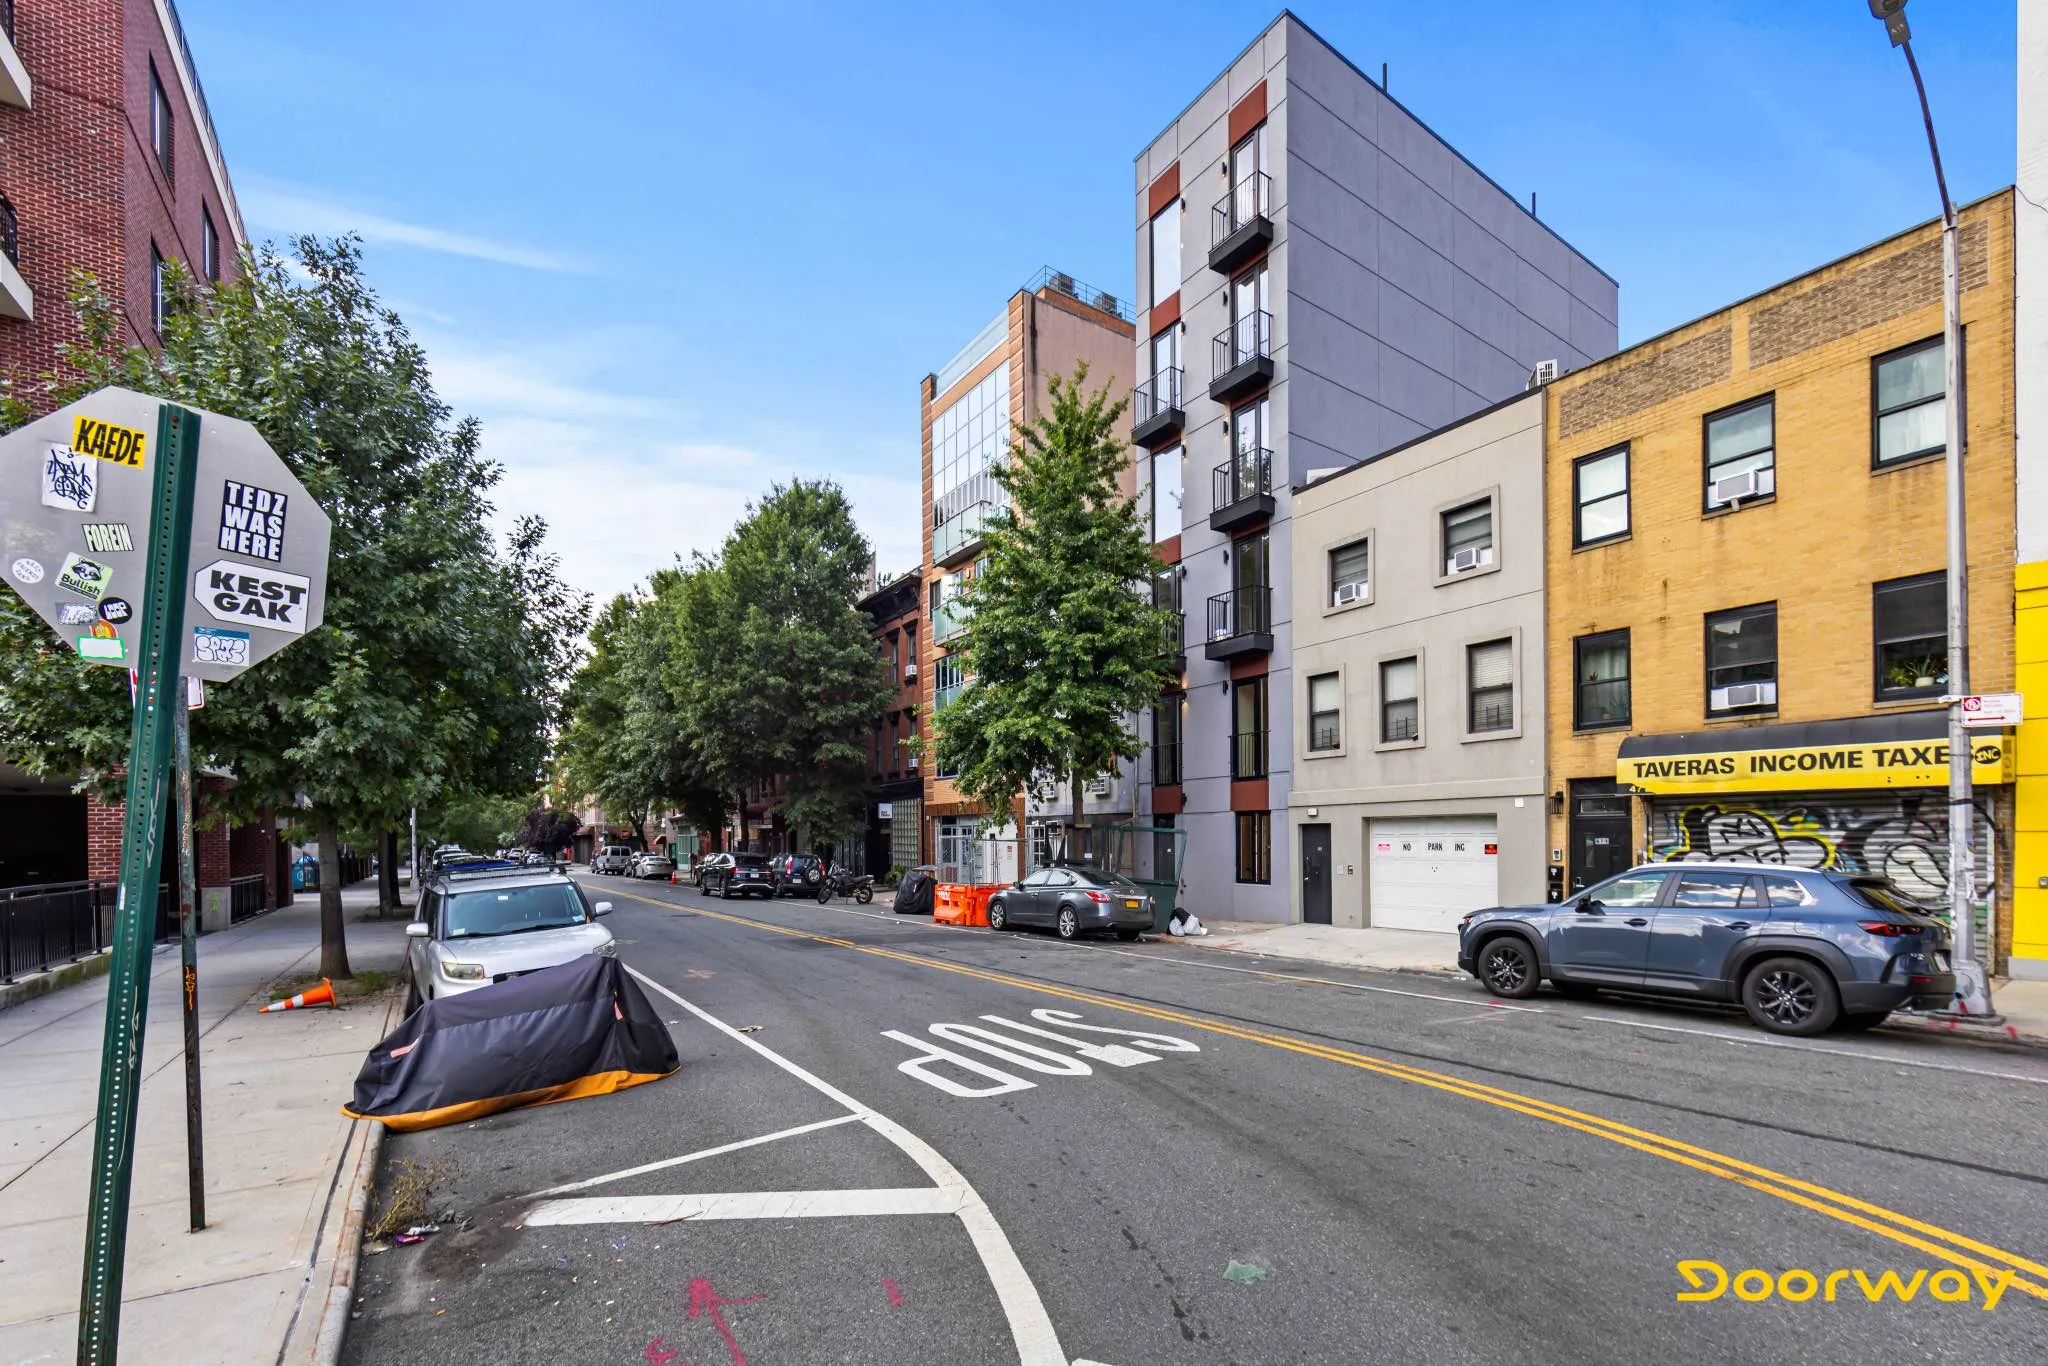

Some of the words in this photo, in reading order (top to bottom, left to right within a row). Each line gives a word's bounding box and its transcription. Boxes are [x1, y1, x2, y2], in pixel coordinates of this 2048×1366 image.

[75, 418, 145, 465] KAEDE
[226, 481, 286, 517] TEDZ
[82, 523, 134, 552] FOREIN
[224, 503, 283, 539] WAS
[219, 526, 281, 562] HERE
[61, 573, 100, 596] Bullish
[210, 569, 307, 605] KEST
[213, 592, 292, 623] GAK
[1633, 757, 1735, 778] TAVERAS
[1750, 750, 1864, 773] INCOME
[1872, 744, 1974, 768] TAXE
[1976, 748, 2000, 761] INC
[1402, 843, 1412, 852] NO
[1427, 842, 1443, 852] PARK
[1454, 842, 1465, 852] ING
[880, 1008, 1200, 1097] STOP
